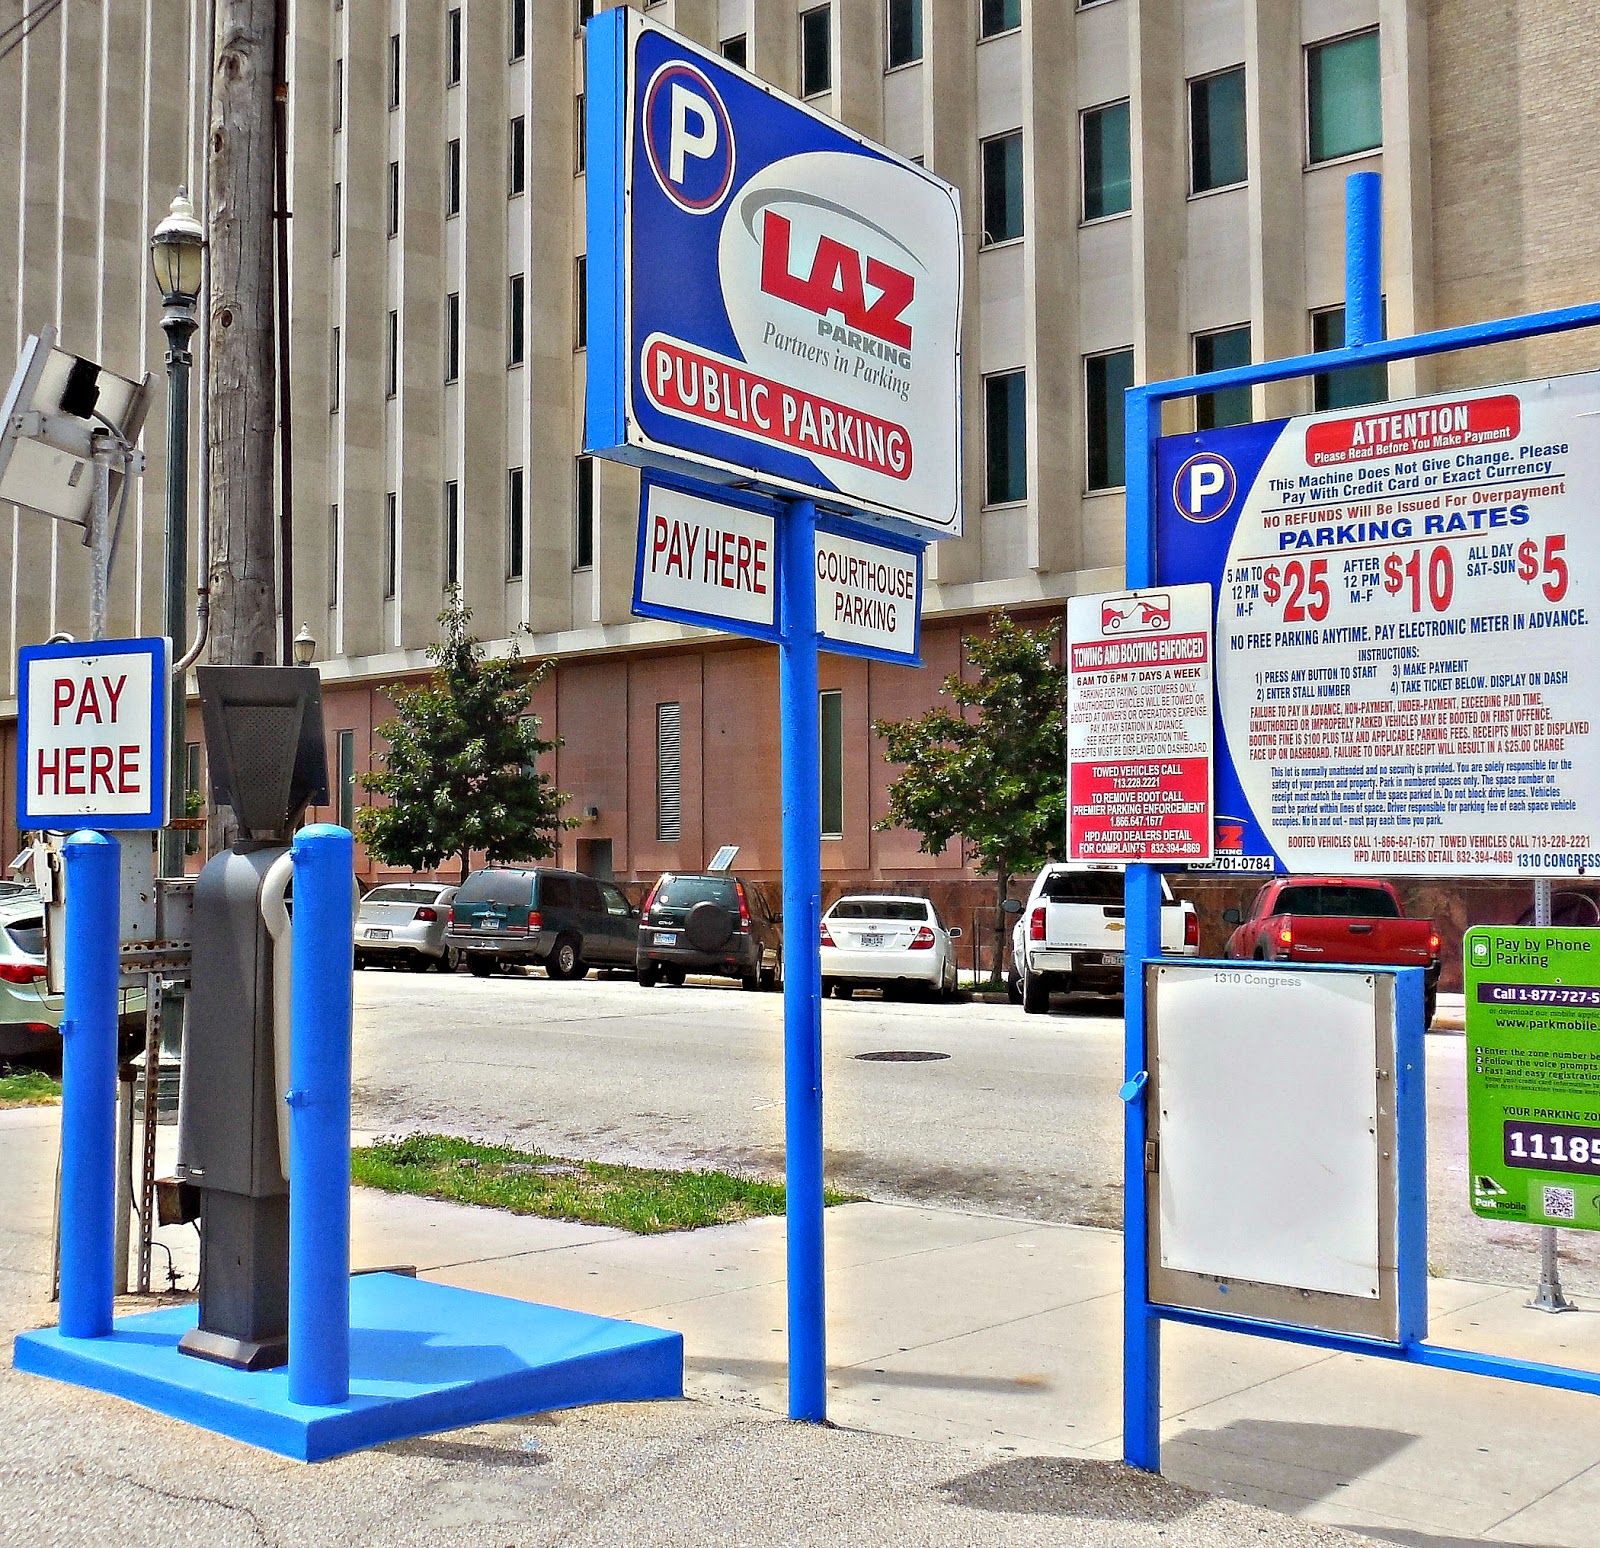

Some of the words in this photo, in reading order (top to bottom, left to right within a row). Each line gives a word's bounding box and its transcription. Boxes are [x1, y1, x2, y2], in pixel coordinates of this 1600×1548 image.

[668, 82, 718, 185] P
[760, 208, 915, 350] LAZ
[817, 319, 911, 370] PARKING
[762, 320, 830, 367] Partners
[833, 348, 849, 374] in
[852, 356, 911, 402] Parking
[656, 349, 771, 430] PUBLIC
[782, 395, 906, 473] PARKING
[1352, 405, 1468, 446] ATTENTION
[1314, 451, 1346, 463] Please
[1349, 446, 1373, 459] Read
[1376, 442, 1409, 455] Before
[1412, 438, 1430, 450] You
[1433, 434, 1461, 447] Make
[1464, 427, 1511, 443] Payment
[1269, 478, 1294, 491] This
[1299, 471, 1353, 488] Machine
[1358, 467, 1390, 481] Does
[1395, 462, 1418, 475] Not
[1422, 458, 1450, 472] Give
[1456, 451, 1514, 467] Change.
[1519, 443, 1569, 459] Please
[1191, 463, 1225, 513] P
[1282, 492, 1305, 504] Pay
[1310, 487, 1339, 501] With
[1343, 481, 1384, 497] Credit
[1388, 476, 1420, 490] Card
[1424, 476, 1438, 486] or
[1442, 468, 1481, 484] Exact
[1486, 461, 1552, 478] Currency
[1263, 515, 1280, 529] NO
[1285, 508, 1343, 526] REFUNDS
[1347, 505, 1371, 519] Will
[1377, 503, 1393, 516] Be
[1397, 497, 1440, 513] Issued
[1445, 495, 1467, 508] For
[1472, 482, 1566, 504] Overpayment
[1279, 518, 1413, 550] PARKING
[1425, 504, 1530, 534] RATES
[651, 514, 700, 580] PAY
[703, 527, 767, 595] HERE
[1468, 547, 1488, 561] ALL
[1491, 543, 1514, 558] DAY
[1344, 557, 1380, 573] AFTER
[1466, 559, 1516, 577] SAT-SUN
[1517, 534, 1569, 603] $5
[817, 549, 914, 600] COURTHOUSE
[1227, 569, 1233, 583] 5
[1235, 567, 1249, 582] AM
[1251, 566, 1262, 581] TO
[1344, 575, 1357, 588] 12
[1361, 573, 1380, 587] PM
[1384, 545, 1454, 613] $10
[1231, 586, 1243, 600] 12
[1245, 584, 1259, 599] PM
[1263, 559, 1331, 623] $25
[1350, 589, 1373, 603] M-F
[834, 591, 896, 633] PARKING
[1236, 602, 1253, 617] M-F
[1231, 635, 1244, 650] NO
[1247, 633, 1272, 649] FREE
[1275, 629, 1319, 647] PARKING
[1322, 626, 1371, 644] ANYTIME.
[1375, 624, 1396, 641] PAY
[1399, 618, 1466, 639] ELECTRONIC
[1471, 615, 1509, 633] METER
[1513, 614, 1525, 630] IN
[1529, 608, 1588, 629] ADVANCE.
[1074, 646, 1103, 668] TOWING
[1104, 645, 1120, 664] AND
[1121, 641, 1158, 663] BOOTING
[1160, 638, 1204, 660] ENFORCED
[1358, 646, 1420, 661] INSTRUCTIONS:
[1098, 675, 1108, 685] TO
[1131, 673, 1136, 682] 7
[1139, 671, 1163, 681] DAYS
[1164, 670, 1171, 680] A
[1174, 667, 1201, 678] WEEK
[1255, 672, 1263, 686] 1)
[1265, 671, 1289, 683] PRESS
[1290, 670, 1306, 682] ANY
[1308, 668, 1338, 681] BUTTON
[1340, 667, 1350, 679] TO
[1352, 665, 1378, 679] START
[1392, 664, 1401, 678] 3)
[1403, 662, 1427, 676] MAKE
[1429, 659, 1469, 674] PAYMENT
[1390, 681, 1399, 695] 4)
[1401, 680, 1422, 694] TAKE
[1424, 678, 1452, 691] TICKET
[1455, 676, 1488, 690] BELOW.
[1490, 673, 1527, 688] DISPLAY
[1528, 673, 1541, 686] ON
[1544, 670, 1568, 685] DASH
[53, 674, 127, 726] PAY
[1256, 688, 1264, 702] 2)
[1266, 687, 1291, 700] ENTER
[1292, 686, 1315, 699] STALL
[1317, 684, 1351, 697] NUMBER
[1472, 725, 1508, 739] RECEIPTS
[1511, 723, 1532, 737] MUST
[1534, 723, 1545, 736] BE
[1547, 721, 1589, 735] DISPLAYED
[37, 745, 140, 796] HERE
[1092, 767, 1119, 777] TOWED
[1120, 765, 1160, 776] VEHICLES
[1161, 764, 1183, 775] CALL
[1092, 793, 1102, 804] TO
[1104, 792, 1136, 803] REMOVE
[1137, 791, 1160, 802] BOOT
[1162, 791, 1184, 801] CALL
[1073, 805, 1106, 816] PREMIER
[1107, 804, 1141, 815] PARKING
[1143, 802, 1205, 814] ENFORCEMENT
[1084, 831, 1100, 842] HPD
[1101, 830, 1122, 841] AUTO
[1124, 830, 1161, 841] DEALERS
[1163, 830, 1192, 841] DETAIL
[1288, 836, 1316, 848] BOOTED
[1317, 835, 1351, 848] VEHICLES
[1353, 835, 1371, 848] CALL
[1374, 835, 1435, 848] 1-866-647-1677
[1440, 835, 1467, 848] TOWED
[1469, 835, 1508, 848] VEHICLES
[1509, 835, 1530, 847] CALL
[1531, 835, 1591, 848] 713-228-2221
[1079, 843, 1094, 854] FOR
[1096, 842, 1146, 854] COMPLAINTS
[1150, 843, 1200, 854] 832-394-4869
[1354, 851, 1369, 862] HPD
[1371, 851, 1391, 862] AUTO
[1393, 851, 1426, 863] DEALERS
[1428, 851, 1454, 863] DETAIL
[1456, 850, 1513, 863] 832-394-4869
[1516, 854, 1541, 867] 1310
[1544, 853, 1600, 867] CONGRESS
[1496, 937, 1520, 952] Pay
[1525, 938, 1541, 952] by
[1546, 938, 1591, 951] Phone
[1496, 952, 1548, 968] Parking
[1214, 973, 1241, 984] 1310
[1244, 974, 1302, 988] Congress
[1493, 988, 1516, 1000] Call
[1485, 1057, 1513, 1066] Follow
[1516, 1058, 1531, 1067] the
[1533, 1060, 1557, 1069] voice
[1560, 1062, 1598, 1071] prompts
[1503, 1106, 1530, 1117] YOUR
[1534, 1108, 1580, 1120] PARKING
